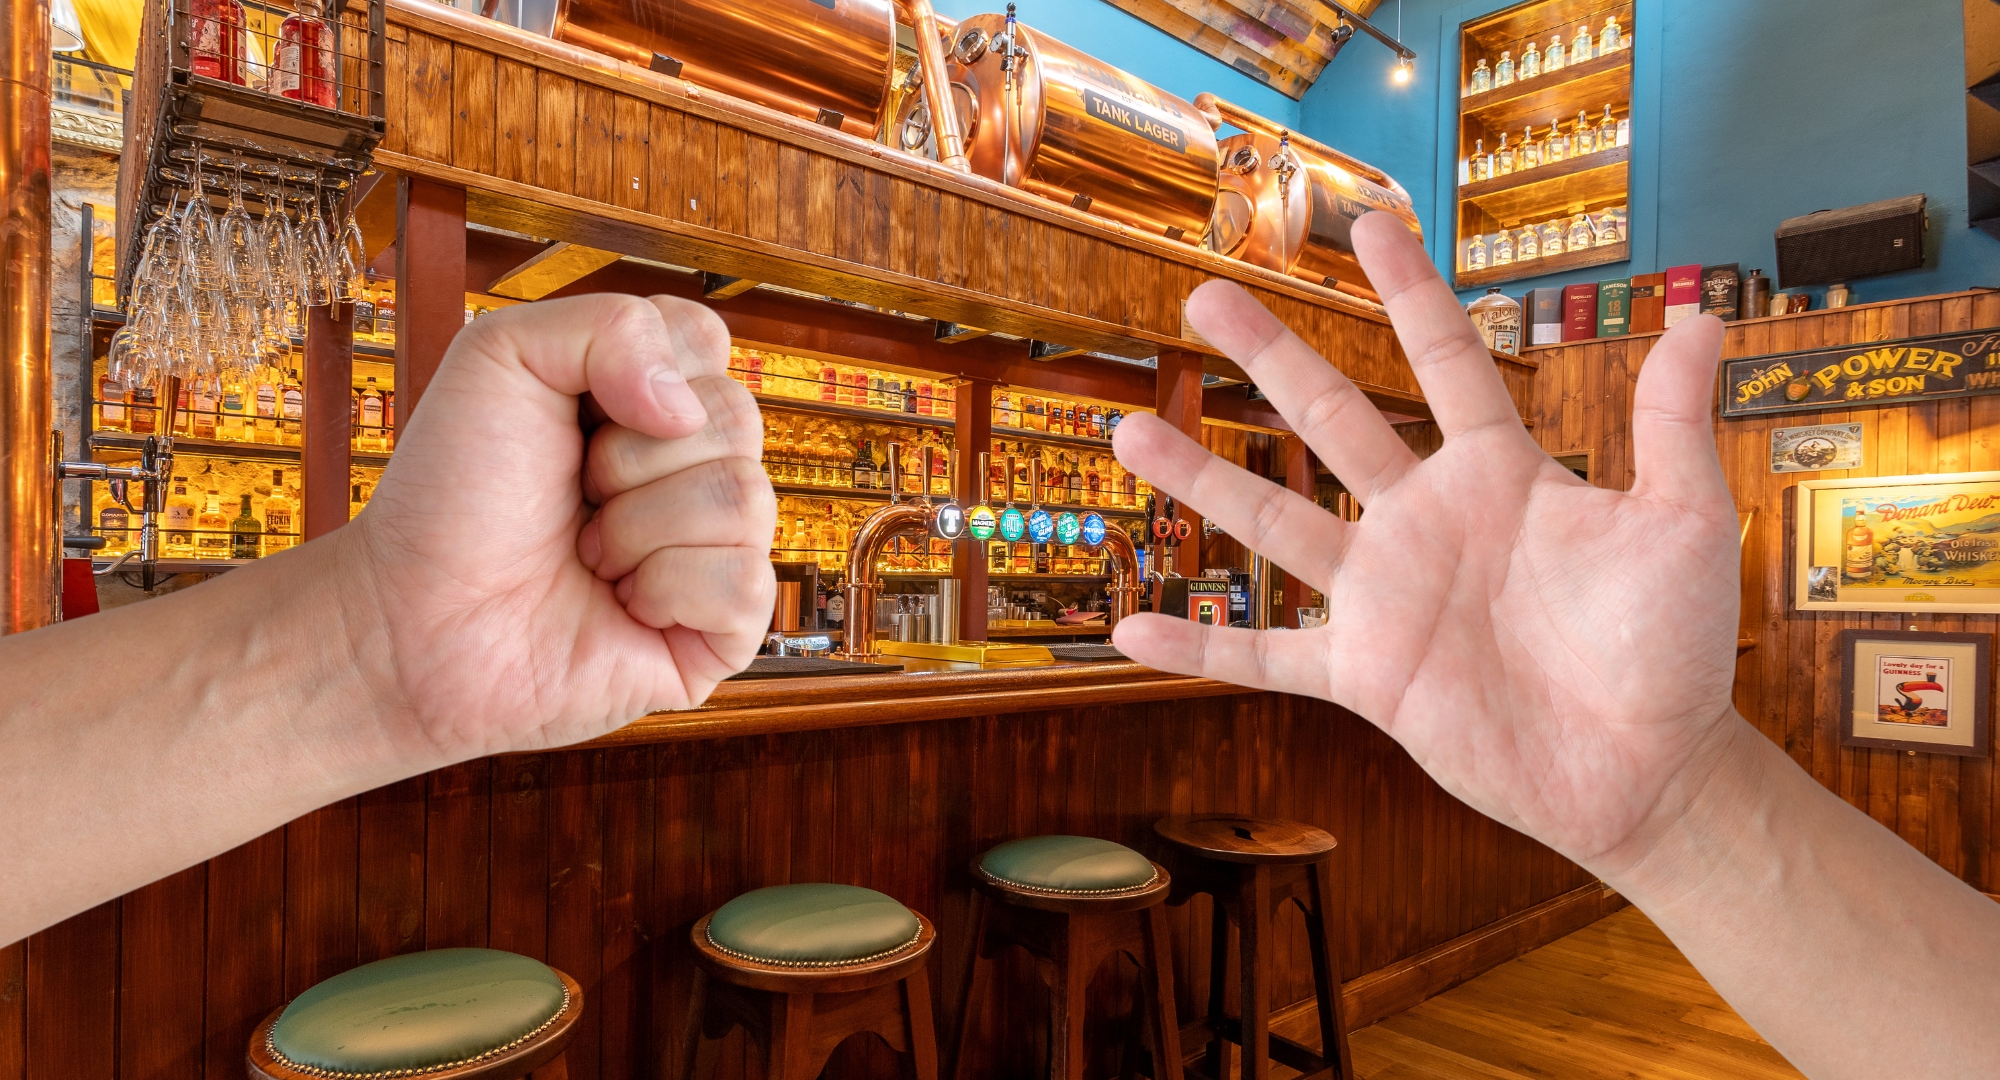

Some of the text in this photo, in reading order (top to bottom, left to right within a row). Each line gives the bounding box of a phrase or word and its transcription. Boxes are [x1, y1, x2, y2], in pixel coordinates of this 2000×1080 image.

[1092, 96, 1179, 147] TANK LAGER
[1602, 282, 1628, 291] JAMESON
[1608, 299, 1621, 312] 18
[1813, 346, 1964, 391] POWER
[1736, 361, 1794, 403] JOHN
[1846, 374, 1927, 398] & SON
[1787, 429, 1816, 441] WHISKEY
[1876, 498, 1952, 523] Donard
[944, 508, 960, 533] T
[972, 519, 995, 527] MAGNERS
[1190, 580, 1227, 592] GUINNESS
[1883, 661, 1908, 669] Lovely
[1882, 668, 1922, 676] GUINNESS
